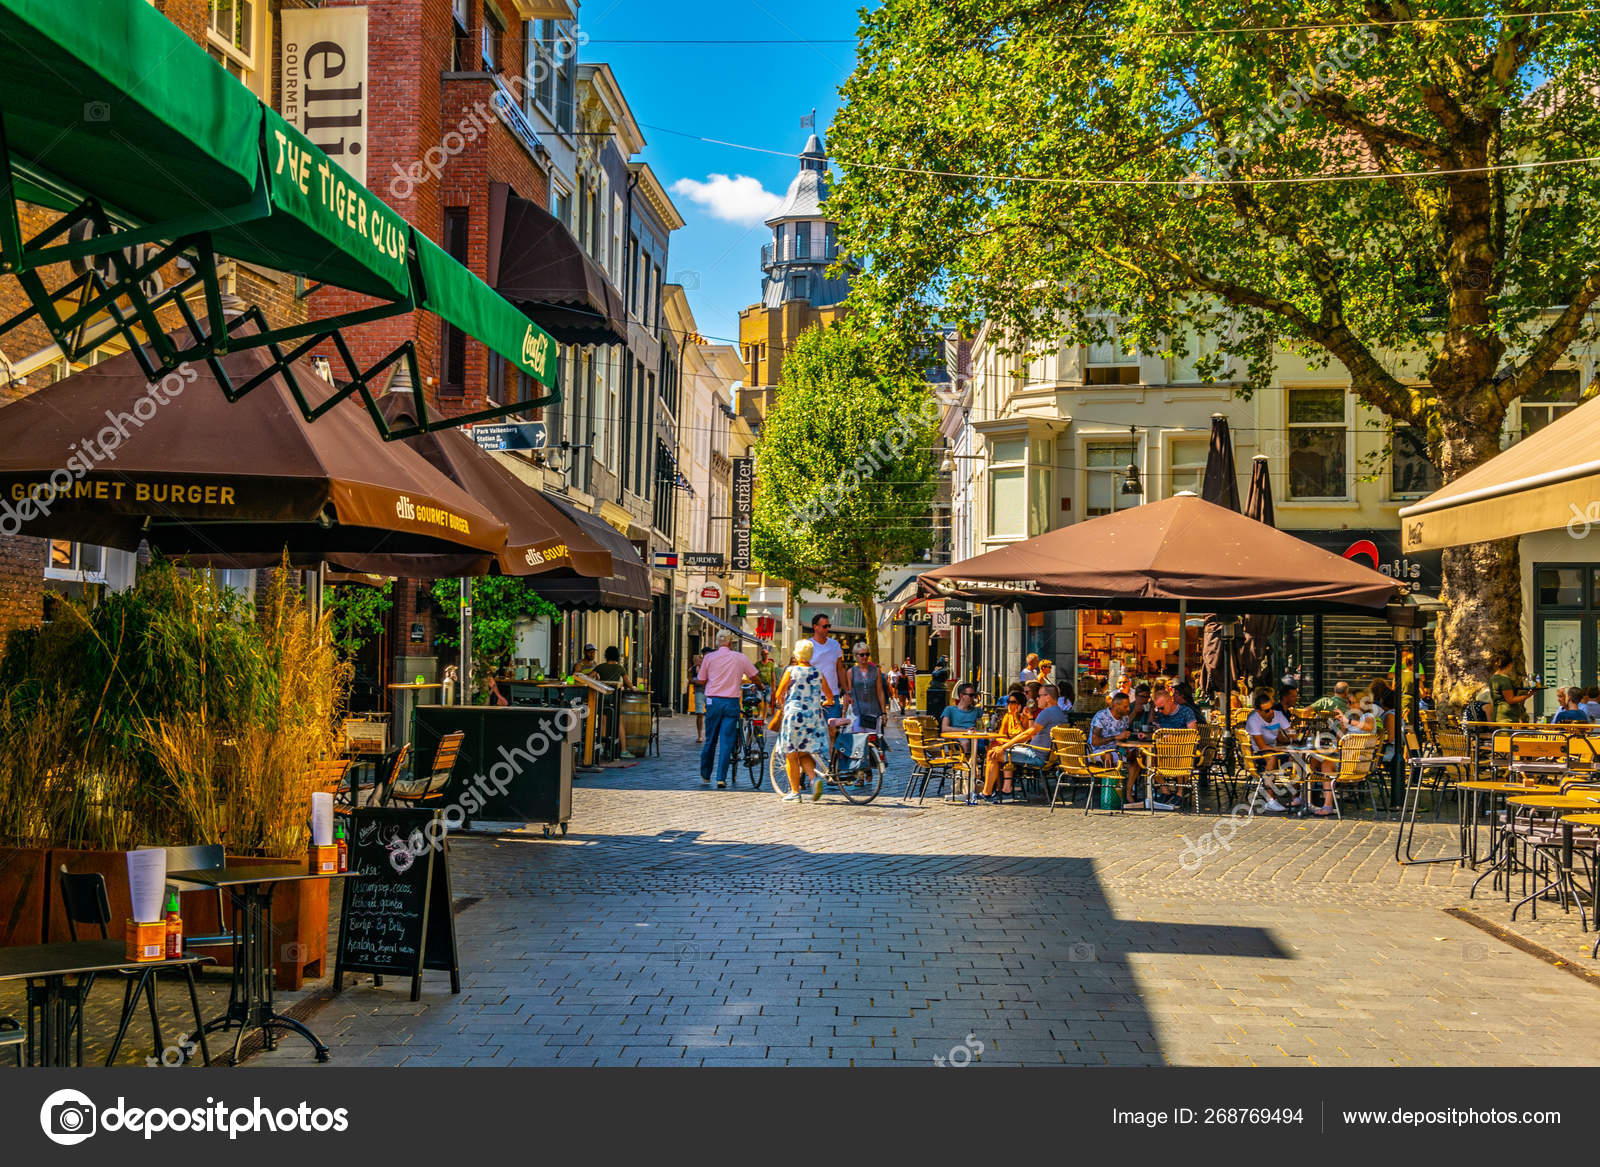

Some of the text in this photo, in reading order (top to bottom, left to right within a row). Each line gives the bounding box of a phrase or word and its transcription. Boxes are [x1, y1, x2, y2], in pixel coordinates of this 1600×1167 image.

[286, 43, 298, 124] GOURMET
[275, 130, 406, 265] THE TIGER CLUB
[11, 481, 235, 505] GOURMET BURGER
[735, 461, 751, 512] sträter
[396, 496, 470, 534] ellis GOURMET BURGER
[525, 548, 544, 566] ellis
